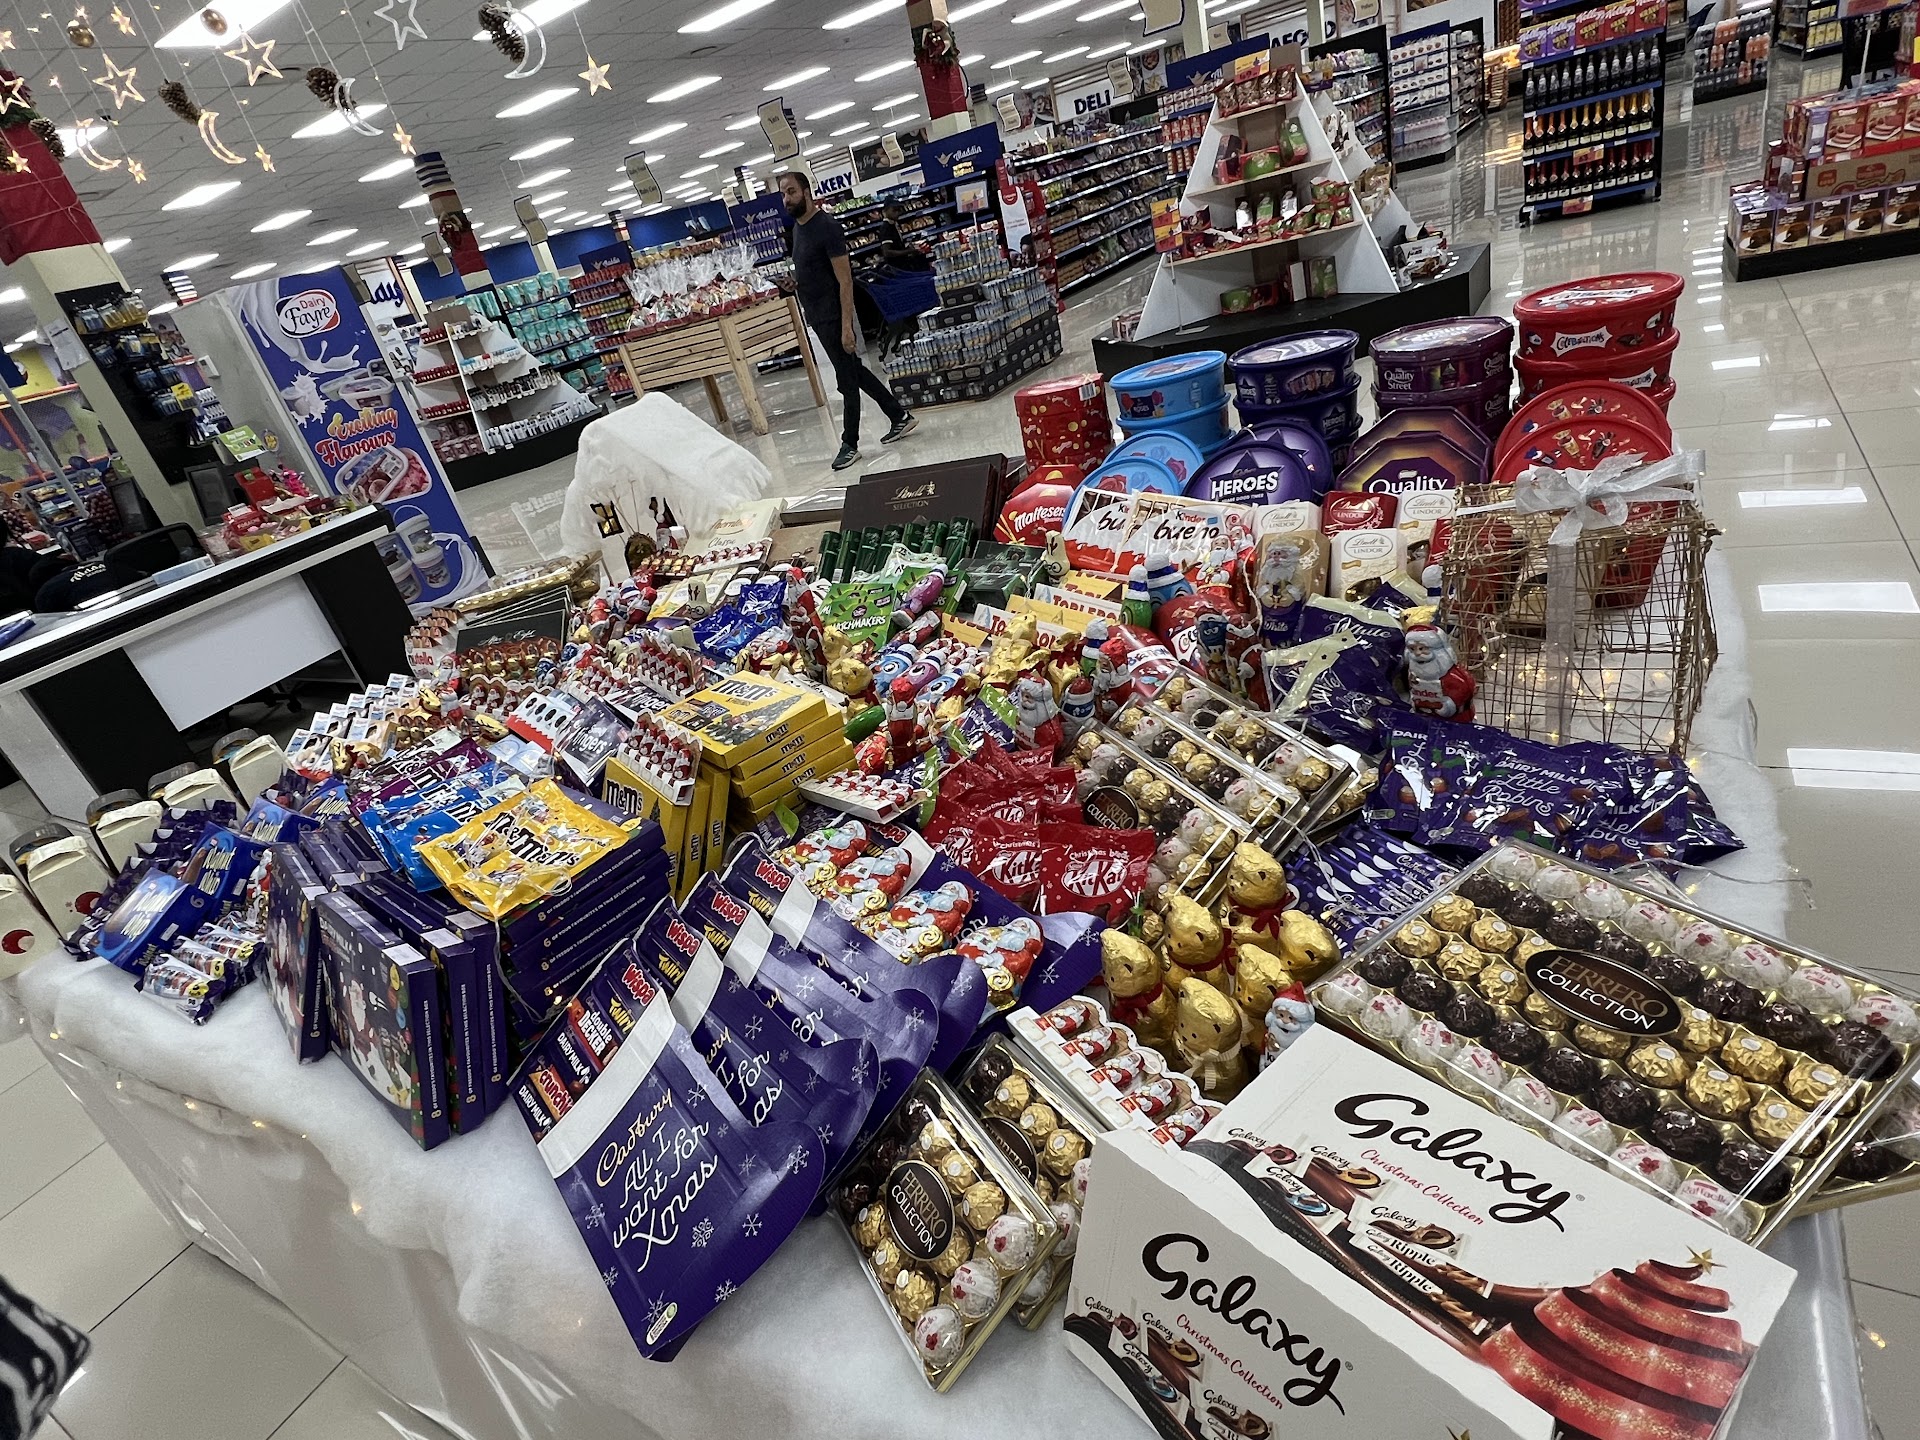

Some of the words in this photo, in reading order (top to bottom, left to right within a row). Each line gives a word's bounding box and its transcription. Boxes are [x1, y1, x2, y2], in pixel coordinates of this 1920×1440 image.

[1074, 90, 1111, 114] DELI
[952, 145, 982, 161] Aladdin
[815, 171, 853, 196] AKERY
[284, 306, 333, 329] Fayre
[299, 297, 326, 310] Dairy
[1384, 370, 1414, 381] Quality
[1387, 382, 1412, 390] Street
[327, 408, 398, 438] Exciting
[315, 431, 395, 467] Flavours
[1211, 471, 1280, 499] HEROES
[1369, 476, 1448, 494] Quality
[892, 501, 929, 511] SELECTION
[1337, 511, 1364, 519] LINDOR
[1393, 730, 1428, 741] DAIR
[1495, 760, 1541, 773] DAIRY
[1539, 769, 1580, 785] MILK
[1502, 772, 1561, 794] Little
[1472, 785, 1556, 817] Robins
[1069, 847, 1107, 860] Christmas
[755, 860, 791, 892] Wispa
[1067, 858, 1127, 896] KitKat
[538, 912, 546, 921] 8
[543, 937, 551, 947] 6
[559, 925, 571, 937] YOUR
[571, 907, 598, 930] FAVOURITES
[613, 882, 636, 901] SELECTION
[711, 891, 747, 925] Wispa
[748, 891, 776, 919] Twirl
[666, 919, 700, 957] Wispa
[703, 924, 732, 951] Twirl
[541, 961, 549, 970] 8
[658, 953, 686, 986] Twirl
[622, 963, 655, 1006] Wispa
[1536, 968, 1656, 1030] COLLECTION
[1546, 954, 1668, 1019] FERRERO
[589, 1010, 613, 1043] double
[608, 997, 636, 1035] Twirl
[577, 1011, 605, 1057] DECKER
[557, 1031, 573, 1057] DAIRY
[567, 1054, 584, 1076] MILK
[491, 1074, 501, 1082] 8
[738, 1051, 770, 1106] for
[466, 1094, 476, 1103] 8
[518, 1085, 536, 1111] DAIRY
[529, 1105, 546, 1127] MILK
[755, 1079, 783, 1127] as
[431, 1110, 441, 1119] 8
[596, 1087, 673, 1187] Cadbury
[1227, 1127, 1268, 1148] Galaxy
[620, 1149, 653, 1209] All
[652, 1122, 671, 1161] I
[1310, 1145, 1350, 1169] Galaxy
[1334, 1093, 1571, 1233] Galaxy
[613, 1169, 668, 1249] want
[671, 1121, 709, 1178] for
[1266, 1166, 1304, 1193] Galaxy
[1360, 1149, 1423, 1190] Christmas
[1422, 1185, 1485, 1226] Collection
[631, 1155, 718, 1273] Xmas
[891, 1185, 936, 1253] COLLECTION
[900, 1168, 948, 1240] FERRERO
[1370, 1206, 1417, 1229] Galaxy
[1390, 1239, 1436, 1266] Ripple
[1390, 1259, 1435, 1293] Ripple
[1085, 1296, 1116, 1318] Galaxy
[1142, 1233, 1346, 1416] Galaxy
[1142, 1312, 1175, 1340] Galaxy
[1123, 1343, 1153, 1374] Galaxy
[1176, 1313, 1230, 1365] Christmas
[1229, 1359, 1283, 1409] Collection
[1203, 1389, 1239, 1417] Galaxy
